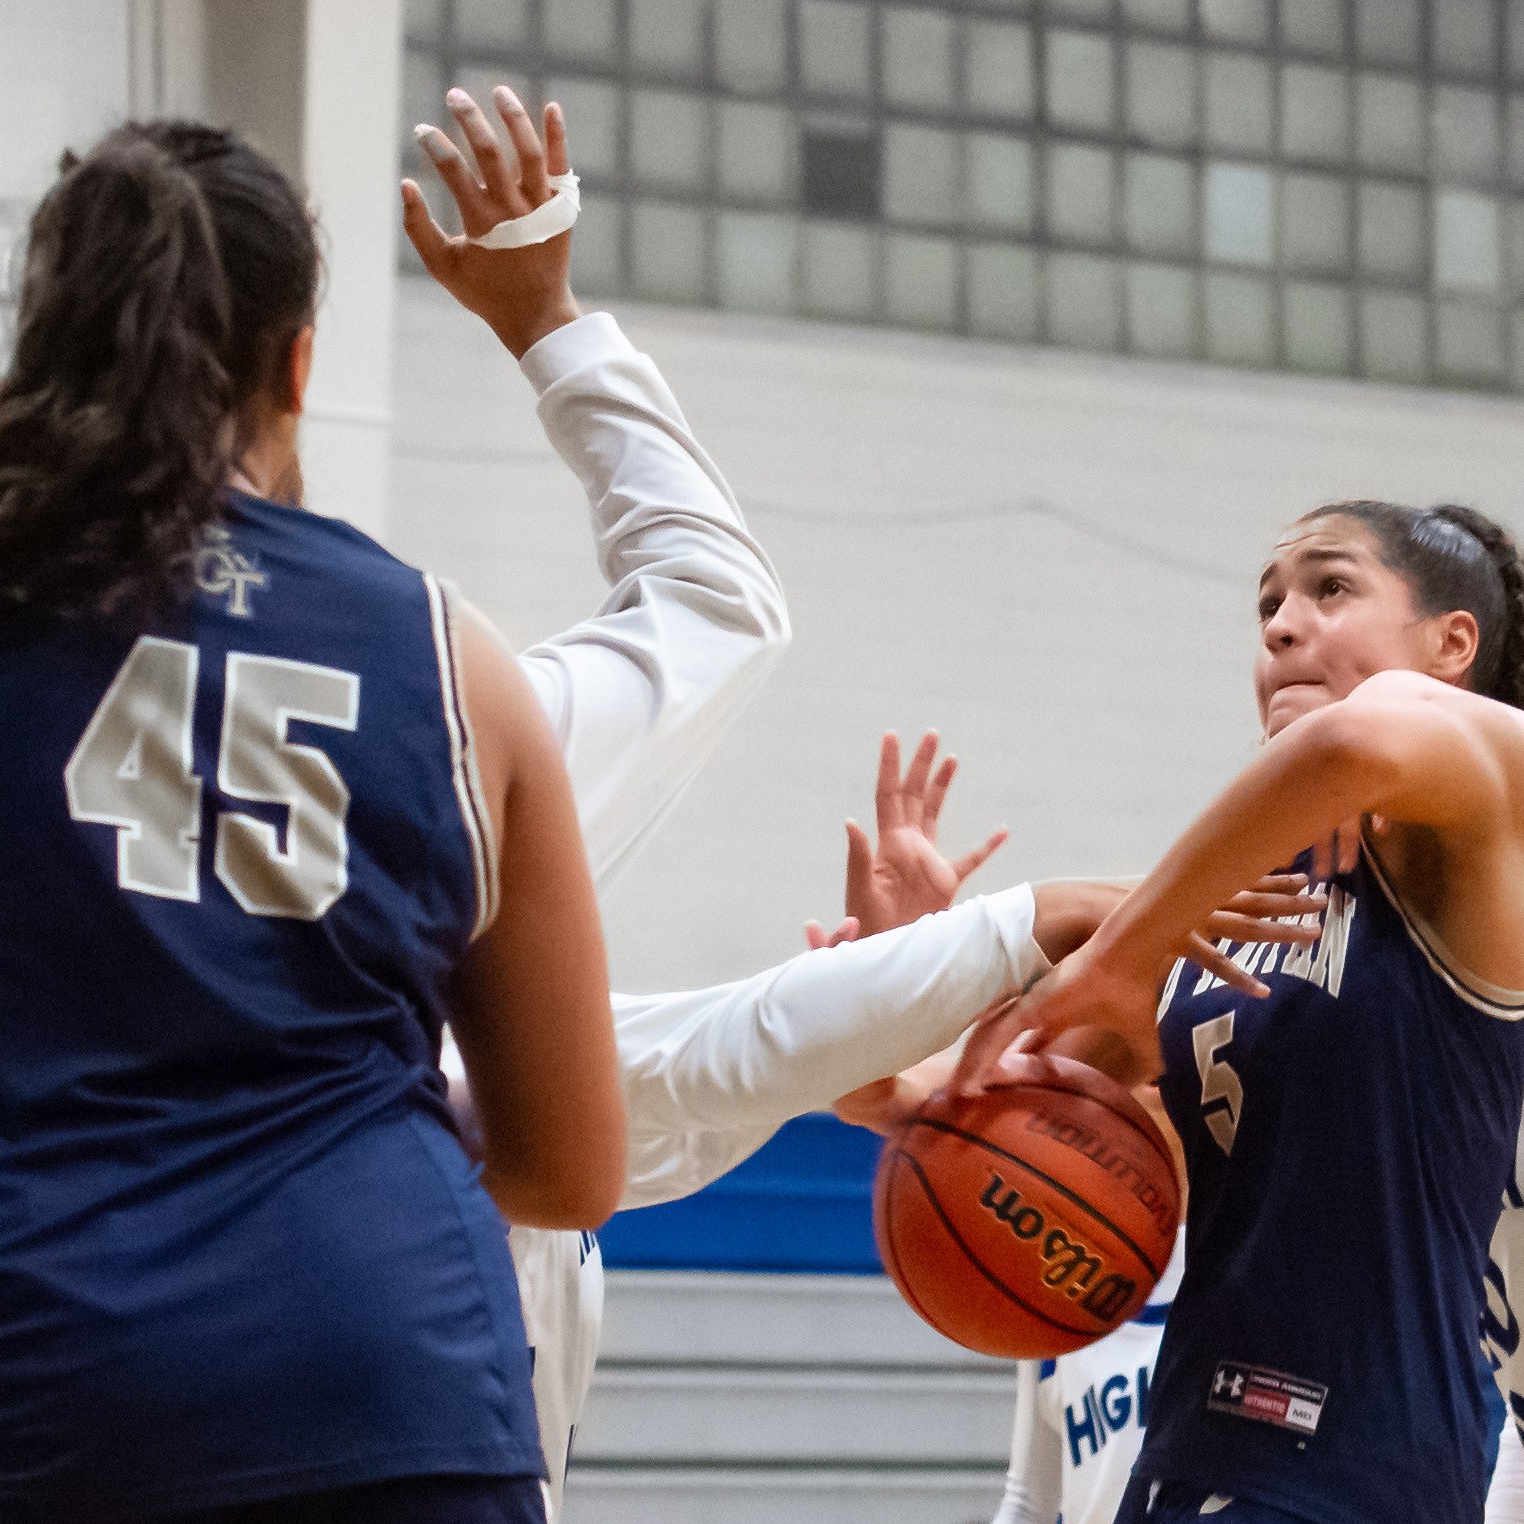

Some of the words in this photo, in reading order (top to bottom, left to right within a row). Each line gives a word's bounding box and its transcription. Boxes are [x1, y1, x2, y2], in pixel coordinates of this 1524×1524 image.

[64, 633, 361, 922] 45
[1192, 1009, 1244, 1158] 5
[979, 1172, 1137, 1324] Wilson
